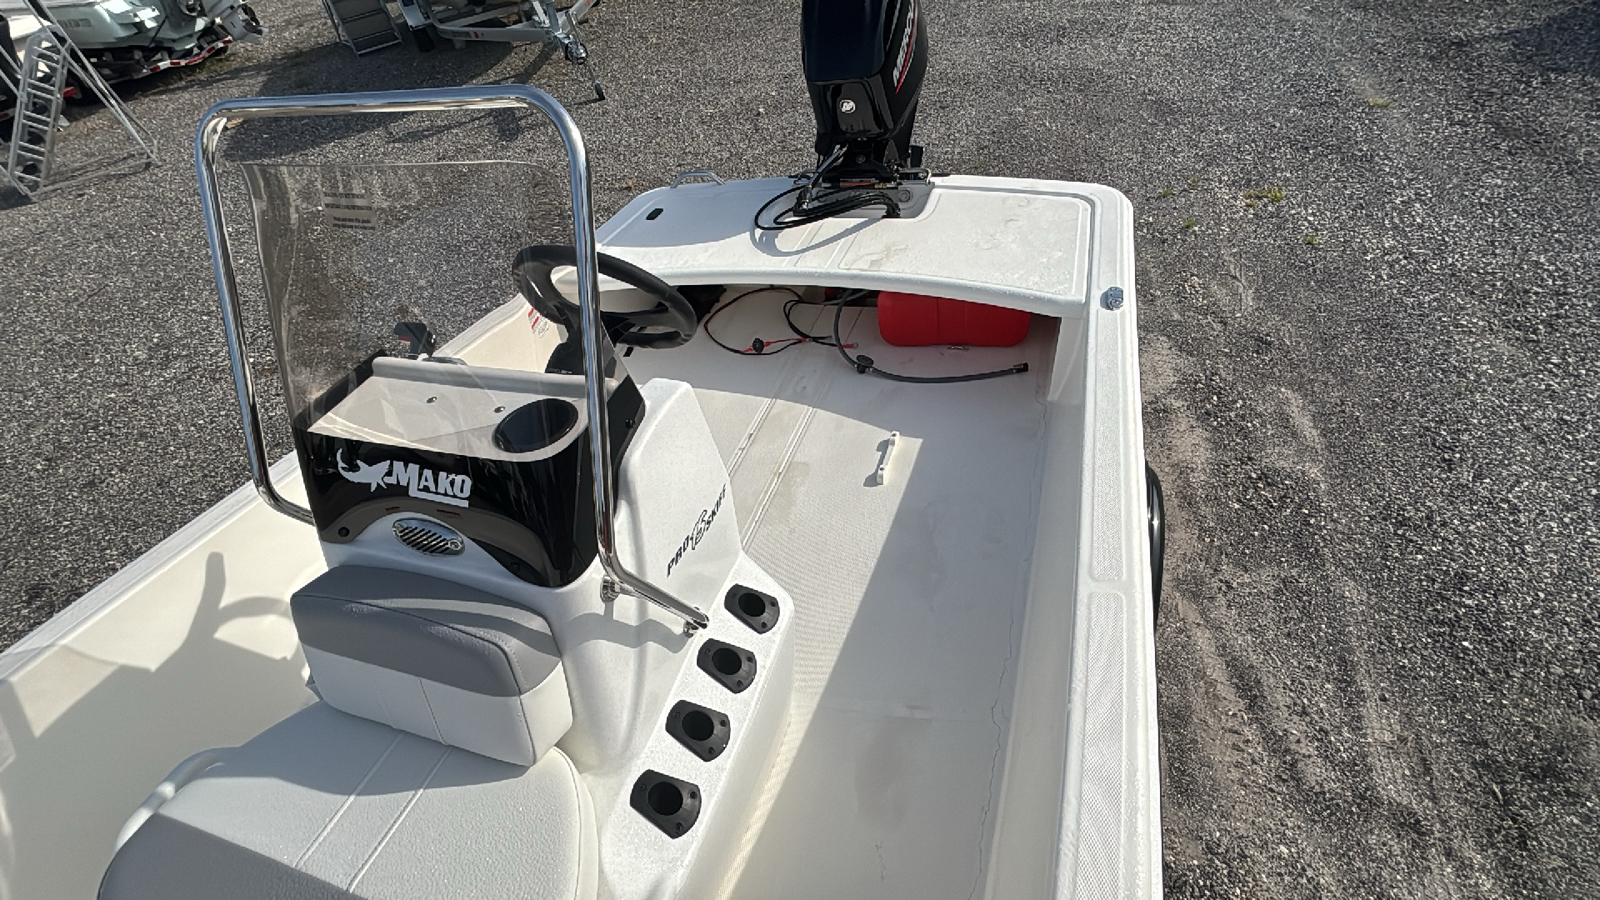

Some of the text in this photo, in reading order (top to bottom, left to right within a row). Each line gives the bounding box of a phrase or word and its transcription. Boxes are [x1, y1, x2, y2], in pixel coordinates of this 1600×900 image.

[385, 460, 473, 508] MAKO
[667, 535, 690, 577] PRO
[706, 483, 726, 532] SKIFF
